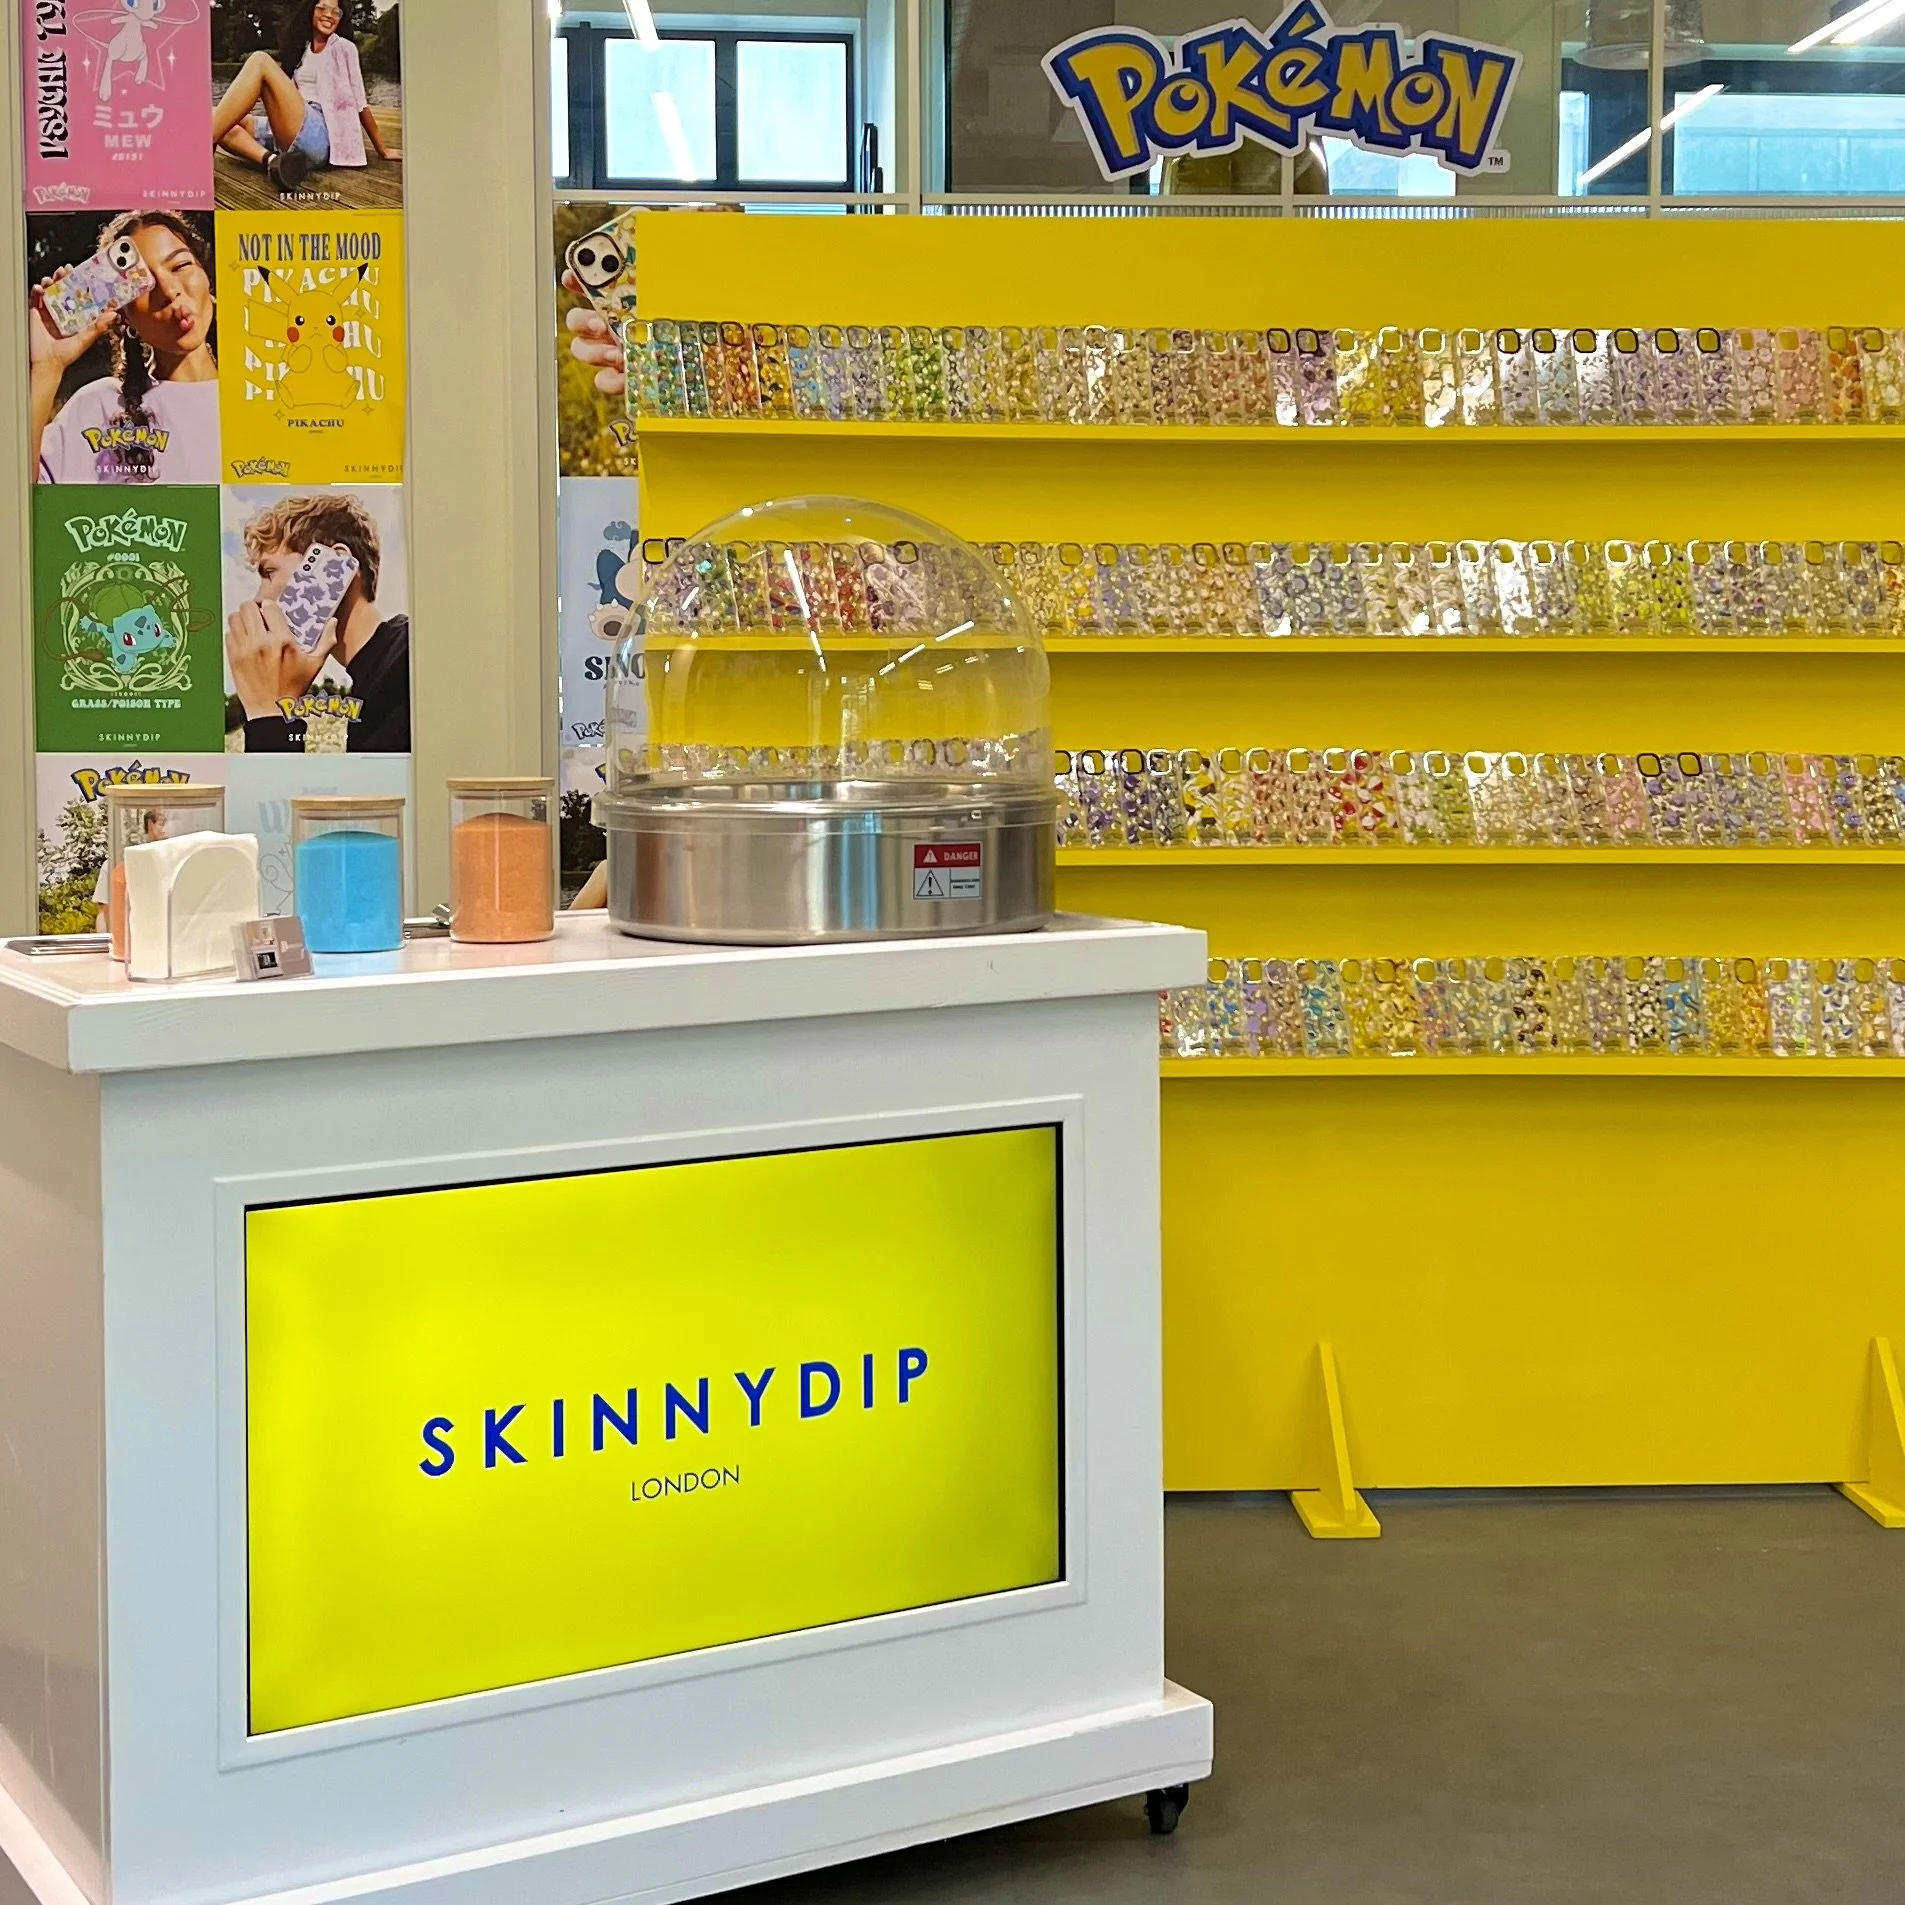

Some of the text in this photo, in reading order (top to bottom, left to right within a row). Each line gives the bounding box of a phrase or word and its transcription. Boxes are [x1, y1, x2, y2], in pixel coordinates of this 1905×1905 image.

[36, 46, 69, 161] PSYCHIC
[93, 103, 164, 129] ミュウ
[104, 134, 152, 148] MEW
[142, 189, 206, 199] SKINNYDIP
[279, 191, 341, 201] SKINNYDIP
[238, 231, 382, 262] NOT IN THE MOOD
[287, 418, 345, 428] PIKACHU
[154, 698, 182, 709] TYPE
[98, 732, 161, 742] SKINNYDIP
[943, 851, 979, 862] DANGER
[418, 1346, 929, 1477] SKINNYDIP
[631, 1464, 740, 1502] LONDON
